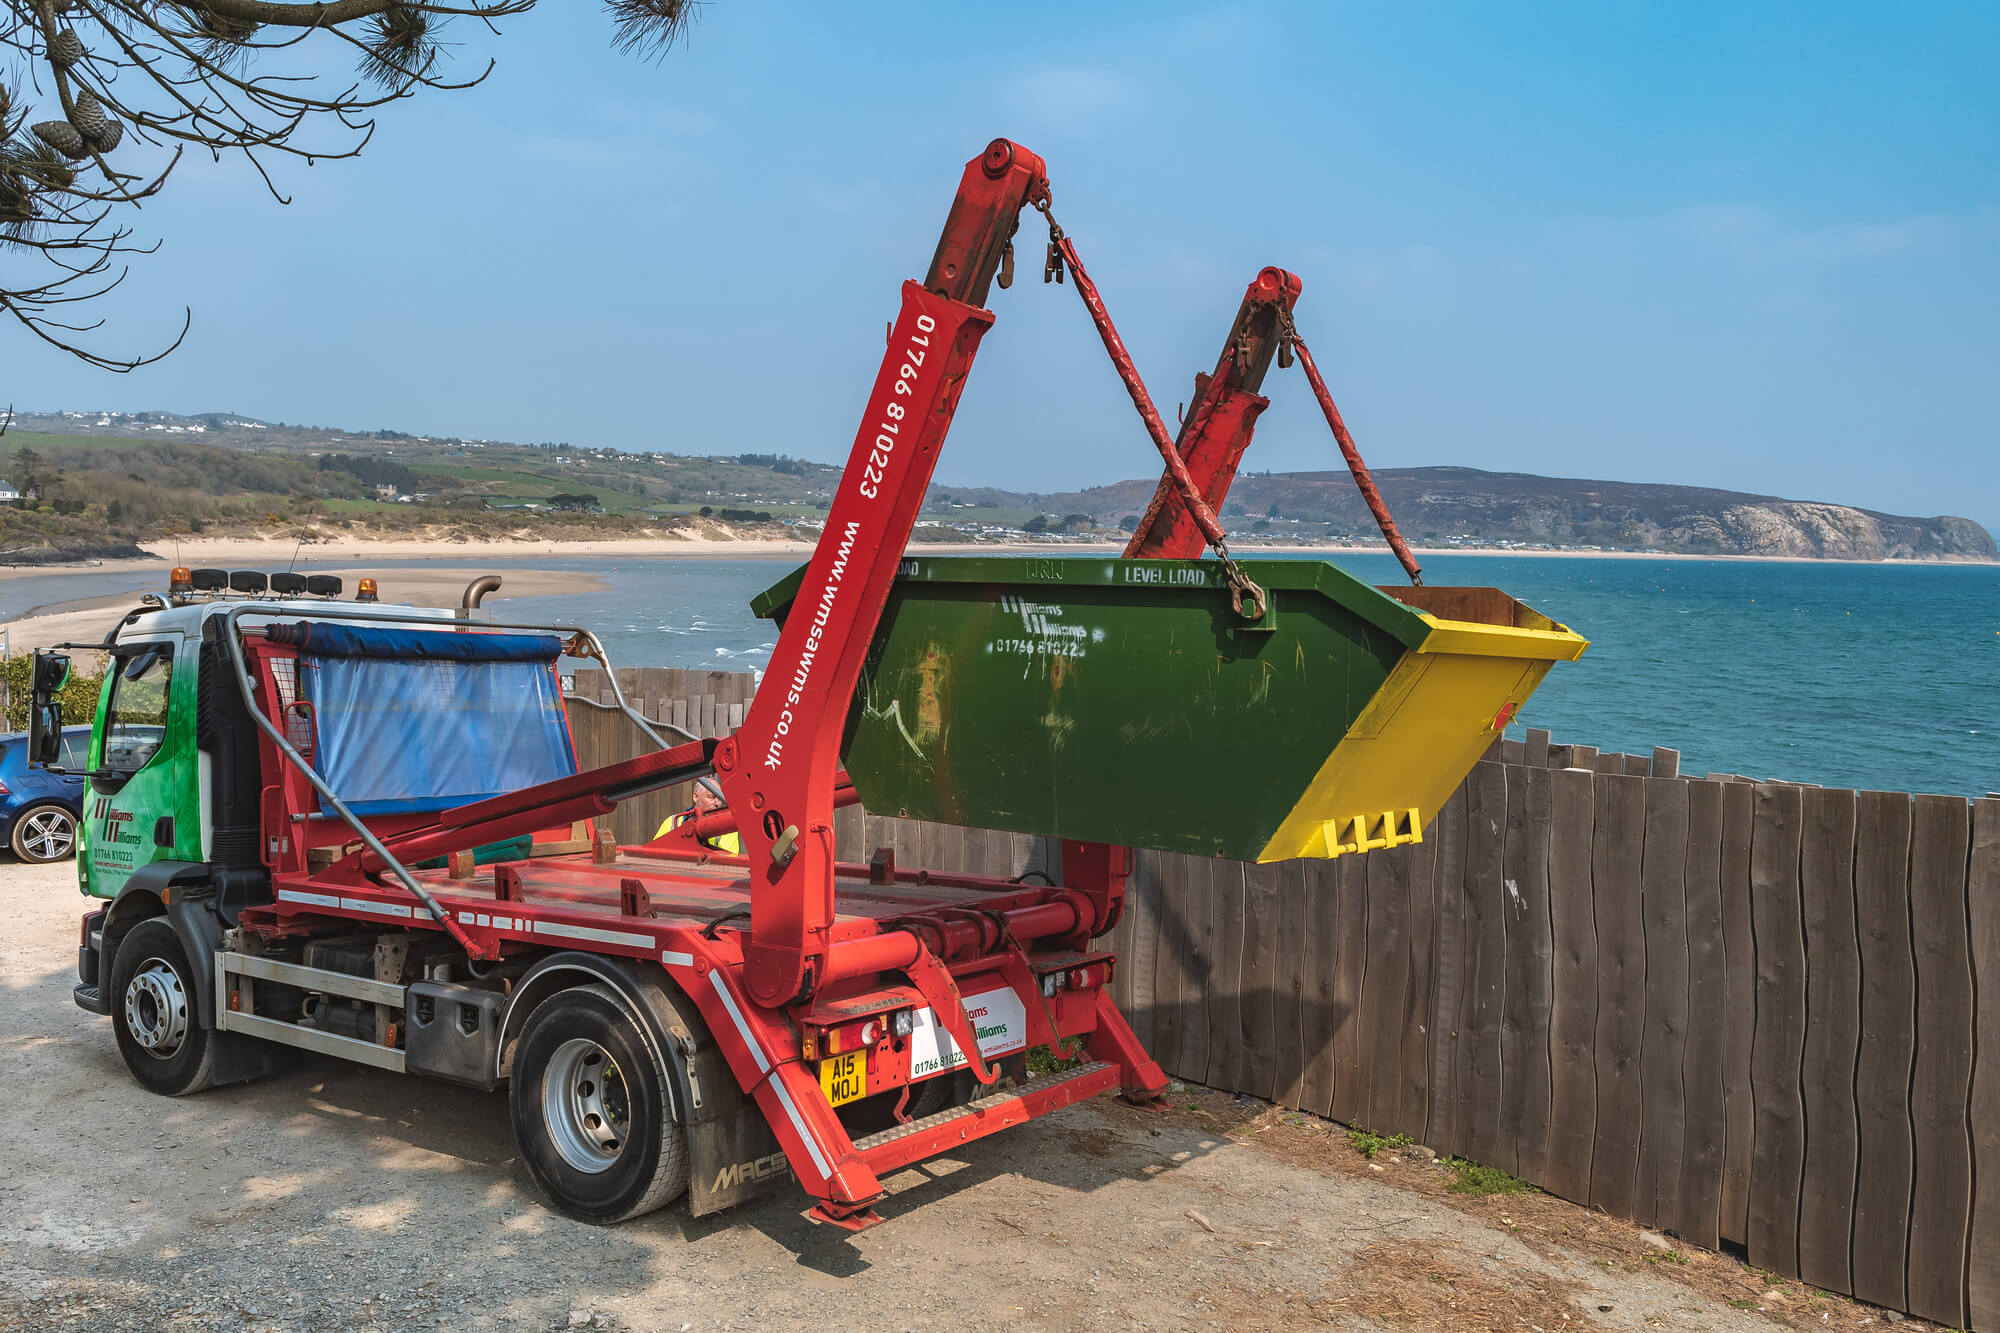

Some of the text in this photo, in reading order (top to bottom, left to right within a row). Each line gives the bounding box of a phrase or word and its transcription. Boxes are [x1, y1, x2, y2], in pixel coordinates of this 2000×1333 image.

[764, 314, 936, 771] 01766 810223 www.wmsawms.co.uk
[1125, 566, 1205, 586] LEVEL LOAD
[996, 639, 1034, 654] 01766
[93, 847, 133, 862] 01766 810223
[832, 1054, 855, 1081] A15
[914, 1058, 939, 1074] 01766
[831, 1075, 859, 1103] MOJ
